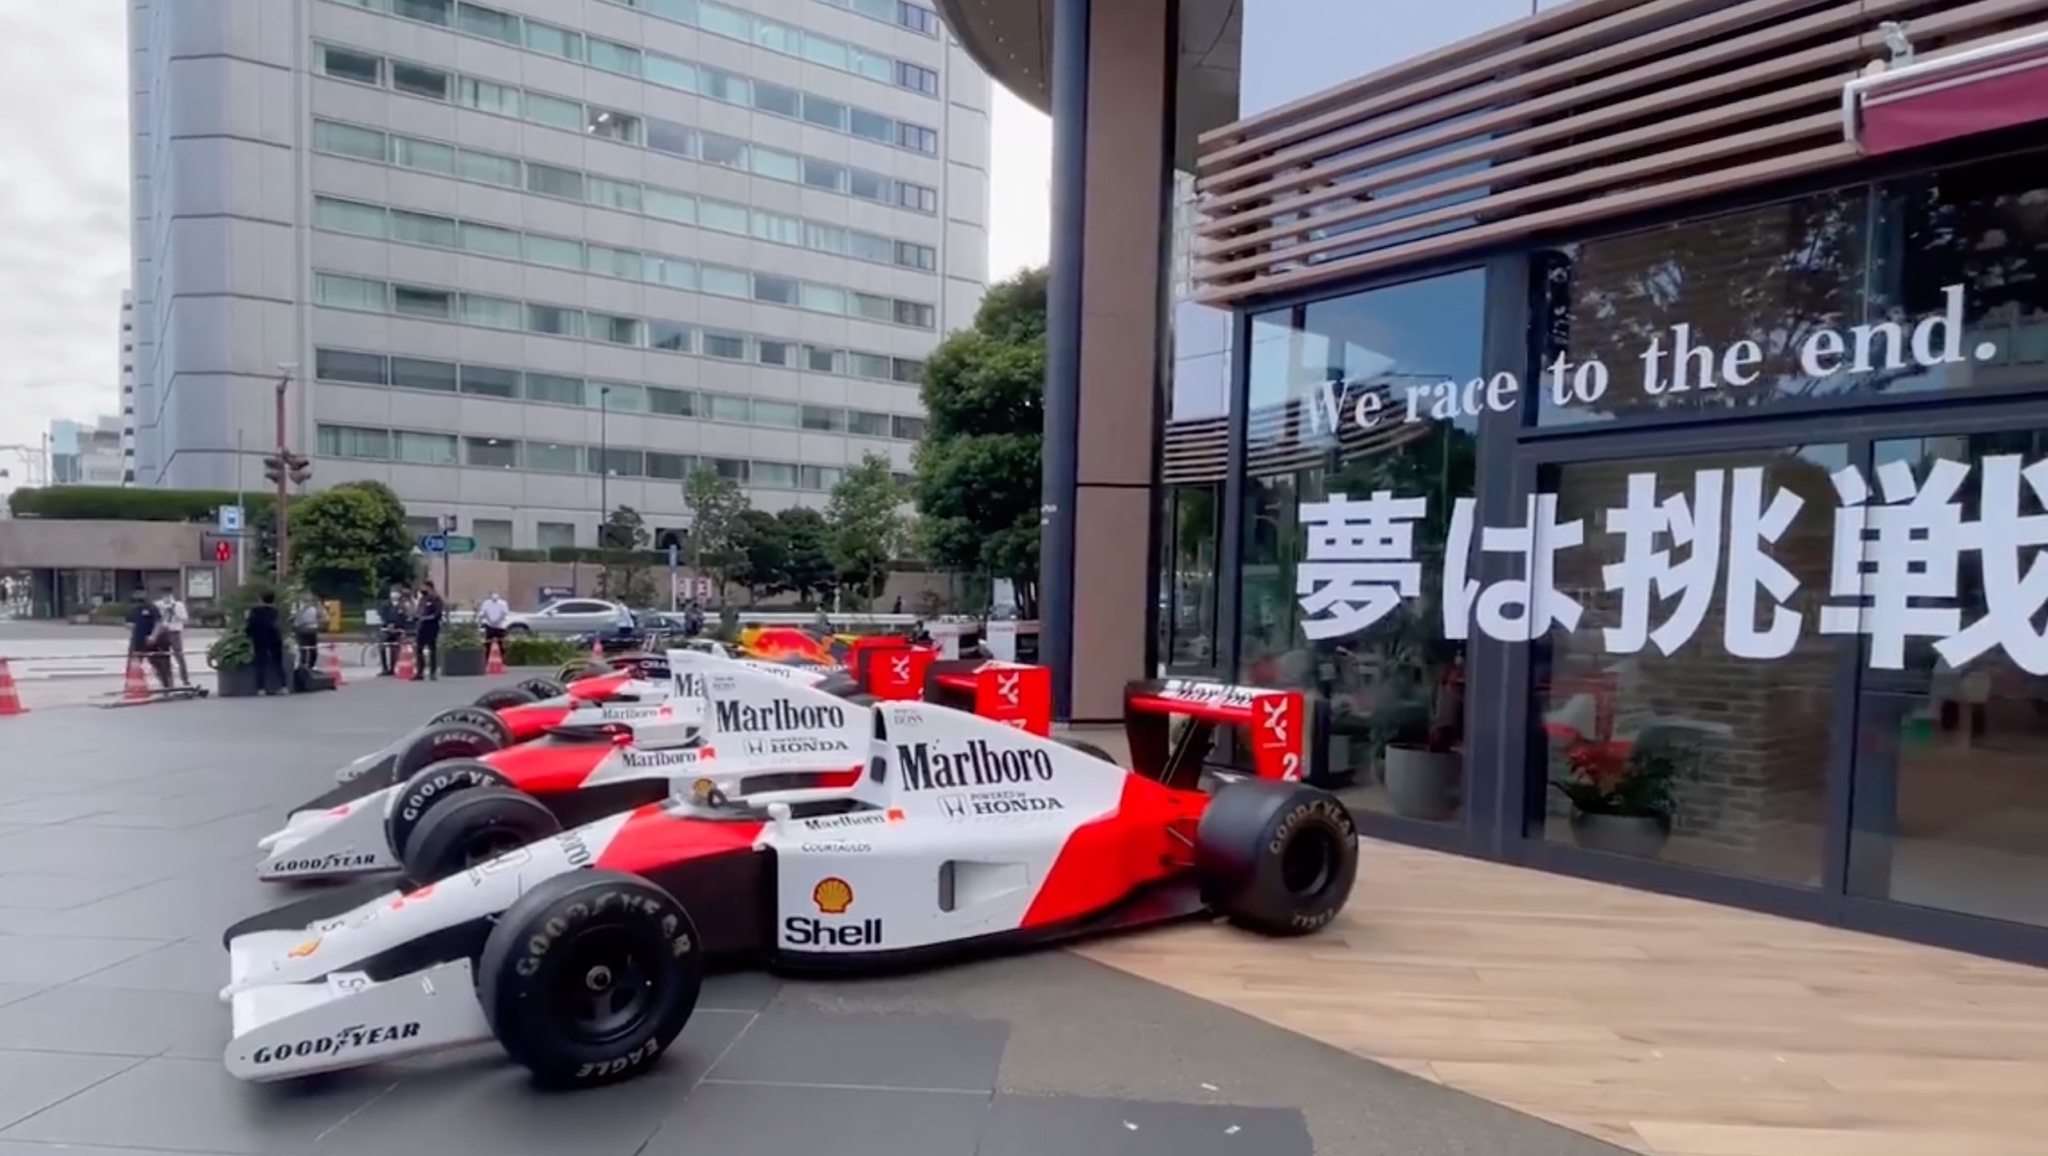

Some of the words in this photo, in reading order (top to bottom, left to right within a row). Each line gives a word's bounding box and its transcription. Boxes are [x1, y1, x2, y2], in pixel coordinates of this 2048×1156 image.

[1304, 379, 1382, 436] We
[1404, 370, 1518, 424] race
[1547, 349, 1608, 407] to
[1640, 322, 1765, 396] the
[1801, 284, 1999, 379] end.
[1297, 453, 2048, 677] 夢は挑戦
[716, 698, 844, 734] Marlboro
[433, 731, 479, 746] EAGLE
[770, 740, 849, 754] HONDA
[622, 751, 696, 768] Marlboro
[897, 739, 1053, 792] Marlboro
[1282, 752, 1298, 781] 2
[972, 796, 1065, 816] HONDA
[804, 814, 886, 831] Marlboro
[274, 853, 377, 872] GOODYEAR
[516, 891, 692, 977] GOODYEAR
[784, 916, 883, 947] Shell
[252, 1021, 422, 1065] GOODYEAR
[574, 1036, 661, 1078] EAGLE
